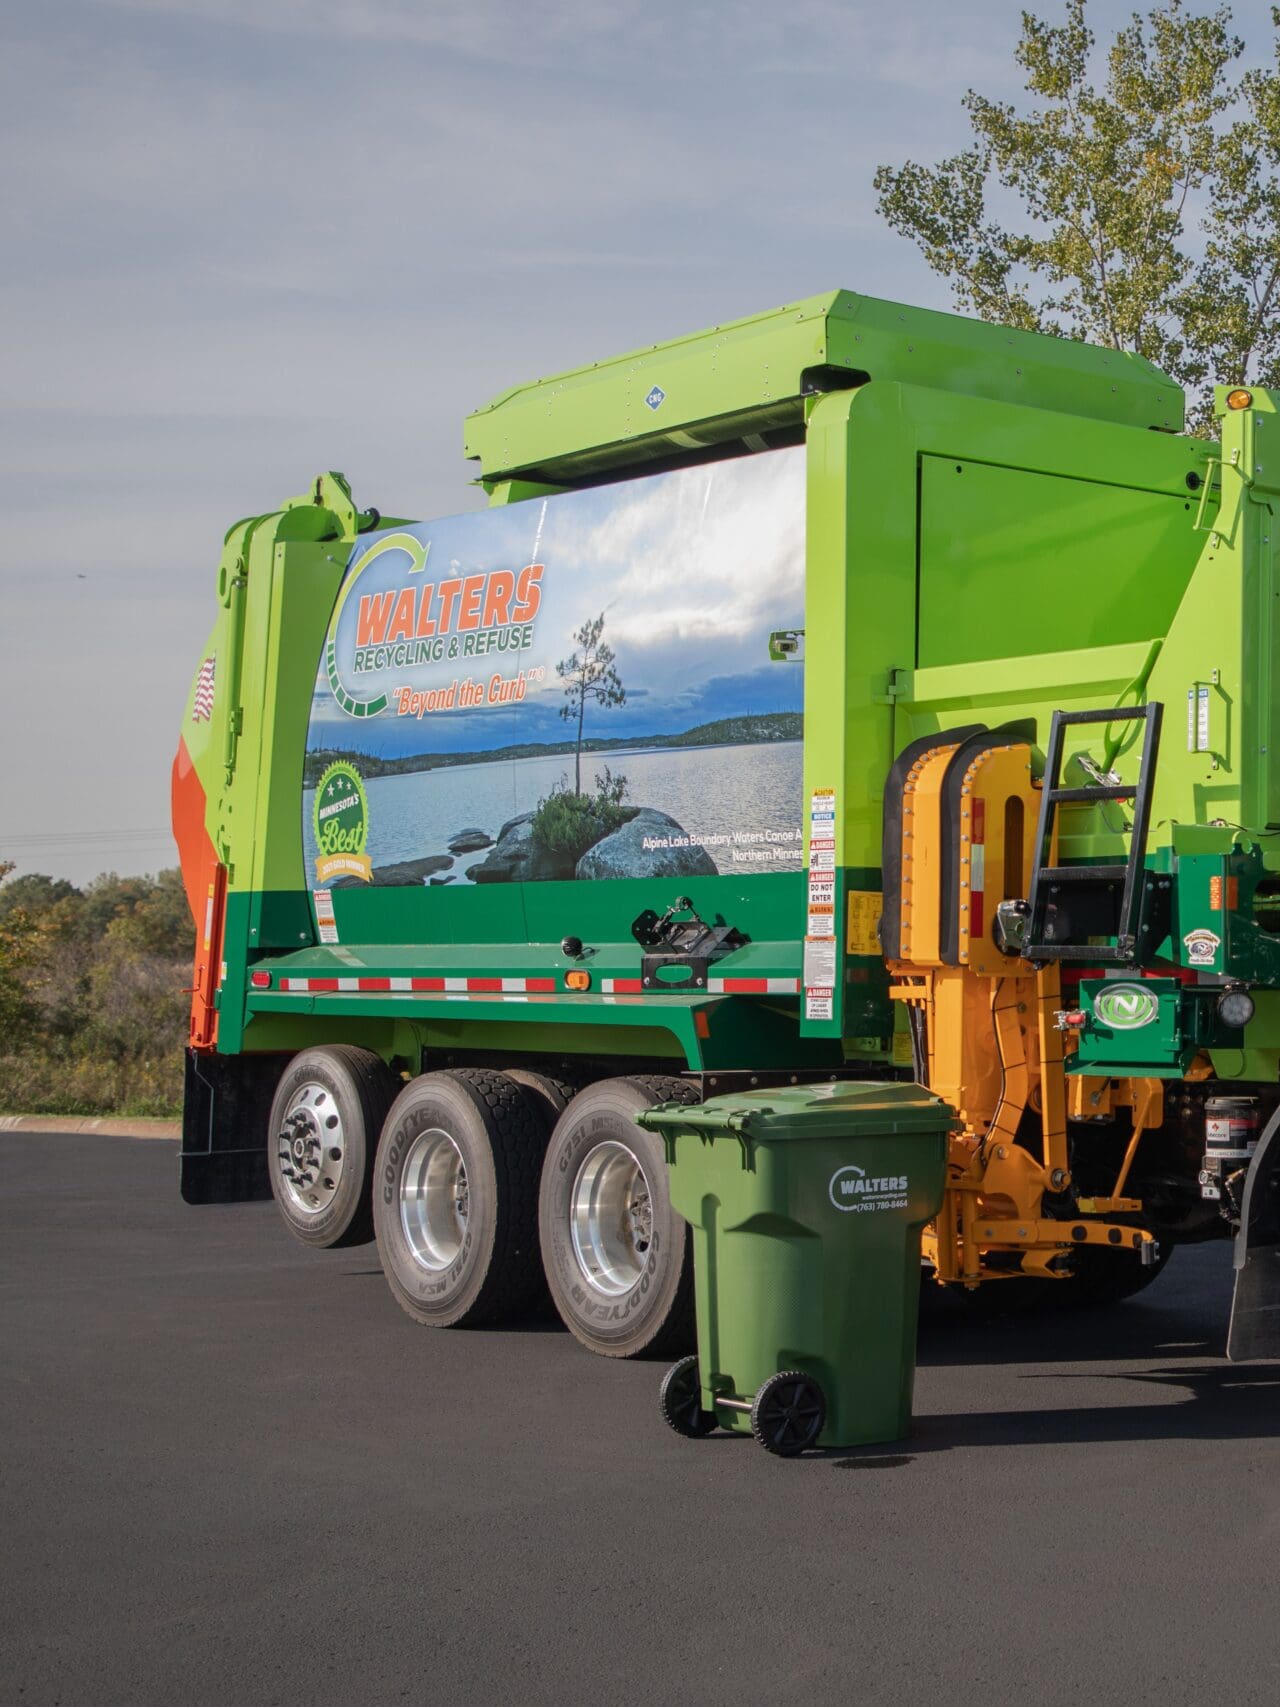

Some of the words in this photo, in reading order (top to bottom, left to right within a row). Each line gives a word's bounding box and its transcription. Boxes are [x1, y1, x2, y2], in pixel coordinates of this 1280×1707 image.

[356, 564, 545, 648] WALTERS
[353, 637, 444, 674] RECYCLING
[447, 636, 459, 660] &
[463, 624, 533, 657] REFUSE
[459, 677, 486, 706] the
[319, 793, 360, 820] MINNESOTA'S
[814, 812, 832, 820] NOTICE
[320, 817, 364, 853] Best
[643, 836, 668, 851] Alpine
[669, 836, 690, 848] Lake
[690, 833, 731, 848] Boundary
[732, 830, 764, 843] Waters
[765, 829, 793, 842] Canoe
[816, 841, 835, 849] DANGER
[732, 849, 771, 862] Northern
[815, 872, 833, 881] DANGER
[810, 884, 819, 892] DO
[811, 894, 832, 902] ENTER
[840, 1176, 909, 1194] WALTERS
[857, 1202, 876, 1212] (763)
[876, 1199, 908, 1209] 780-8464
[571, 1229, 660, 1321] GOODYEAR
